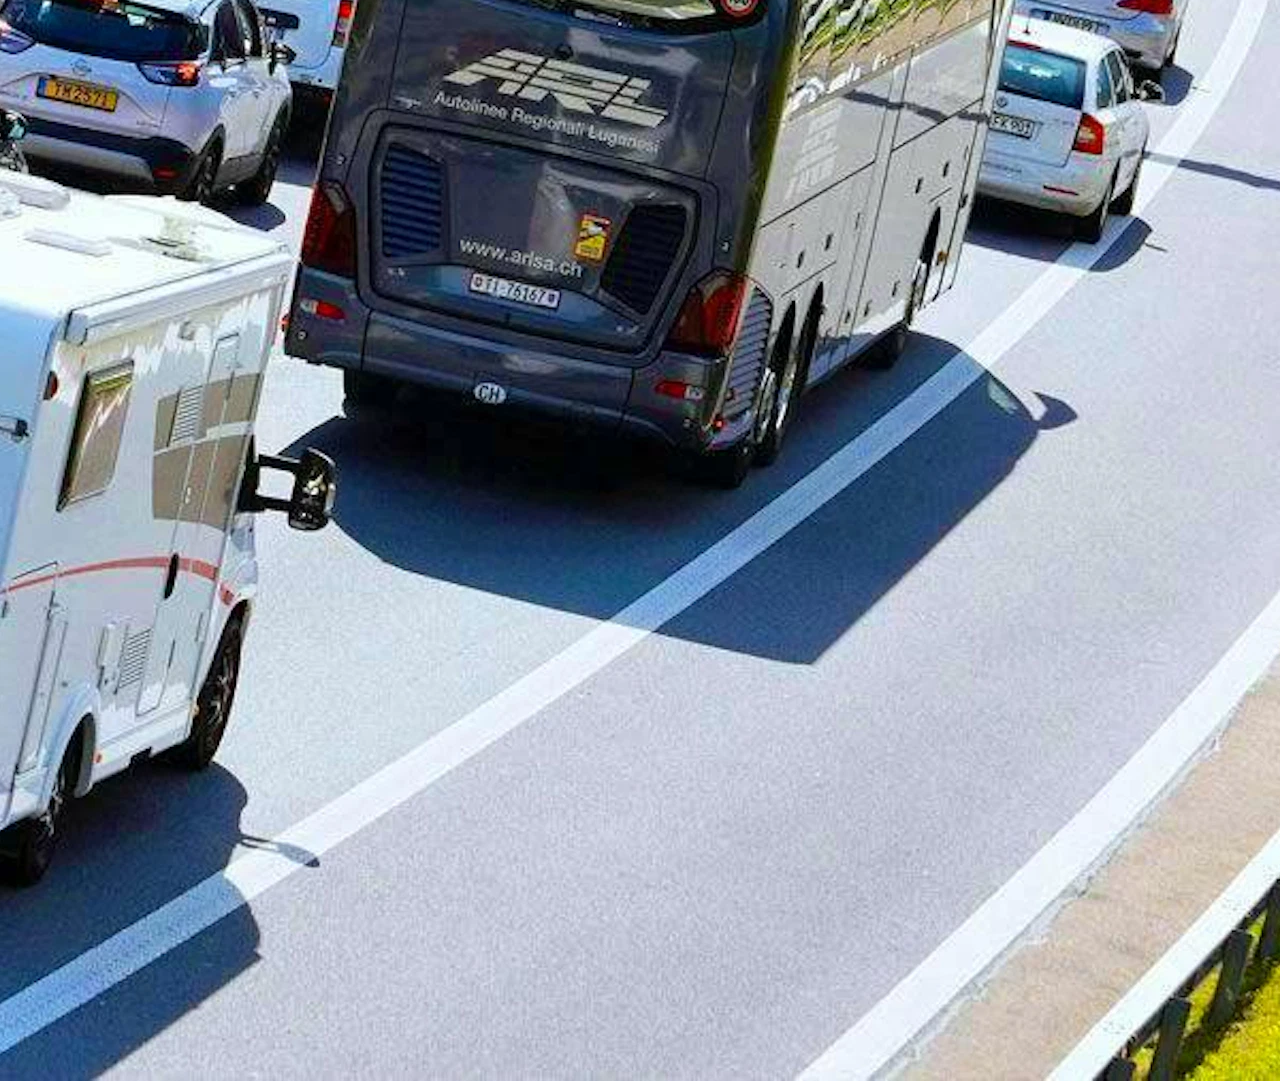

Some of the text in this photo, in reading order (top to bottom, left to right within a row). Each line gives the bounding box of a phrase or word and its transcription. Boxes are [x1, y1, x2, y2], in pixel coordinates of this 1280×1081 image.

[443, 48, 669, 129] ARL
[434, 90, 661, 155] Autolinee Regionali Luganesi
[459, 238, 583, 278] www.arlsa.ch
[479, 385, 500, 402] CH
